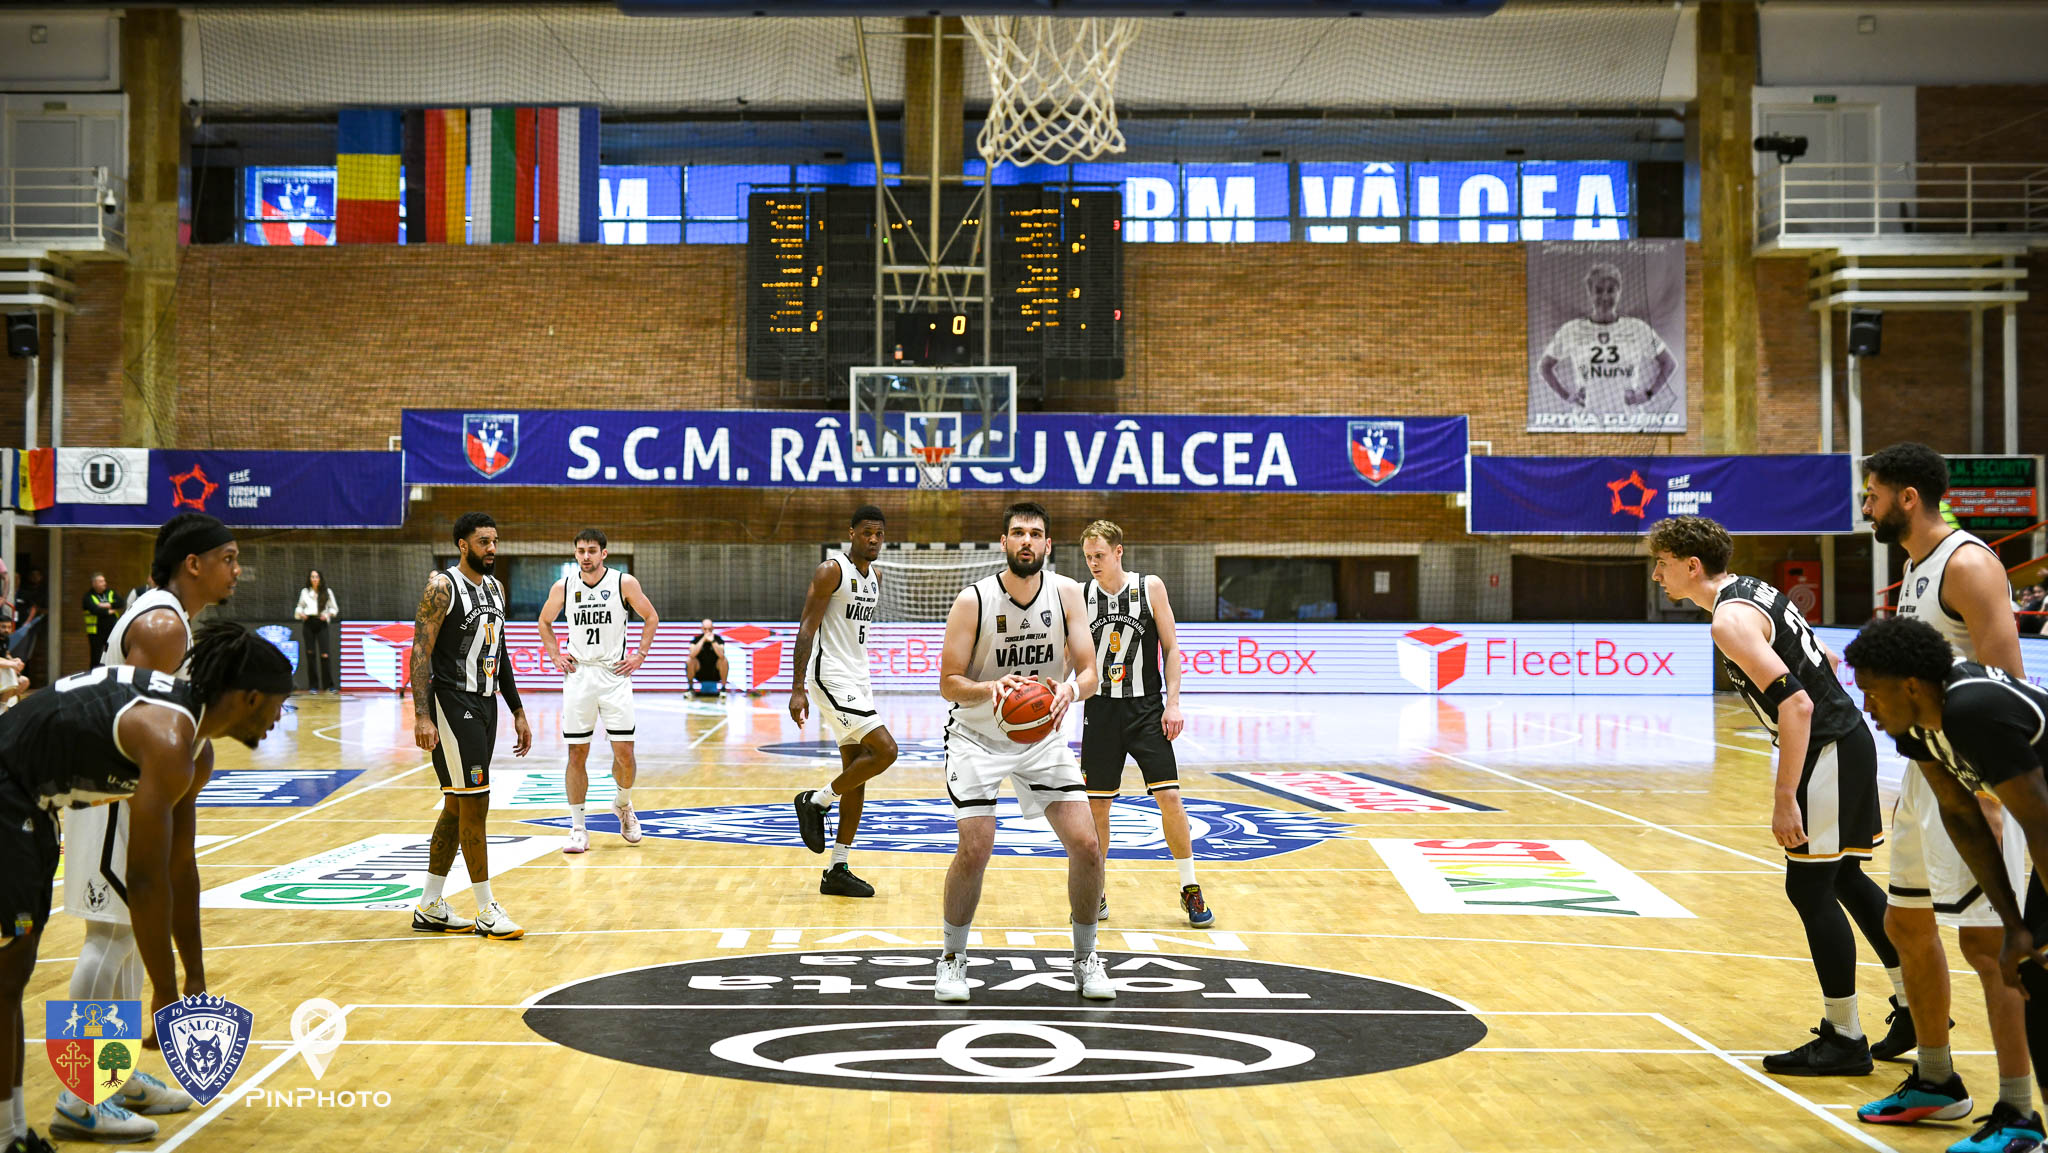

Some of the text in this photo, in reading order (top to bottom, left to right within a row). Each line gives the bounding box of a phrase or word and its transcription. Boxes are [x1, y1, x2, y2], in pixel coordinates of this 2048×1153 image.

[1591, 346, 1620, 364] 23
[567, 425, 749, 481] S.C.M.
[1064, 420, 1298, 486] VÂLCEA
[90, 463, 115, 488] U
[229, 486, 271, 498] EUROPEAN
[1668, 491, 1712, 503] EUROPEAN
[574, 610, 612, 626] VÂLCEA
[1108, 614, 1146, 636] TRANSILVANIA
[483, 623, 496, 645] 11
[586, 627, 600, 645] 21
[858, 625, 866, 645] 5
[1109, 632, 1121, 653] 9
[995, 644, 1054, 668] VÂLCEA
[1486, 638, 1675, 676] FleetBox
[1111, 667, 1122, 675] BT
[1250, 772, 1450, 812] STRABAG
[1413, 838, 1640, 916] STICKY
[687, 971, 1311, 999] Toyota
